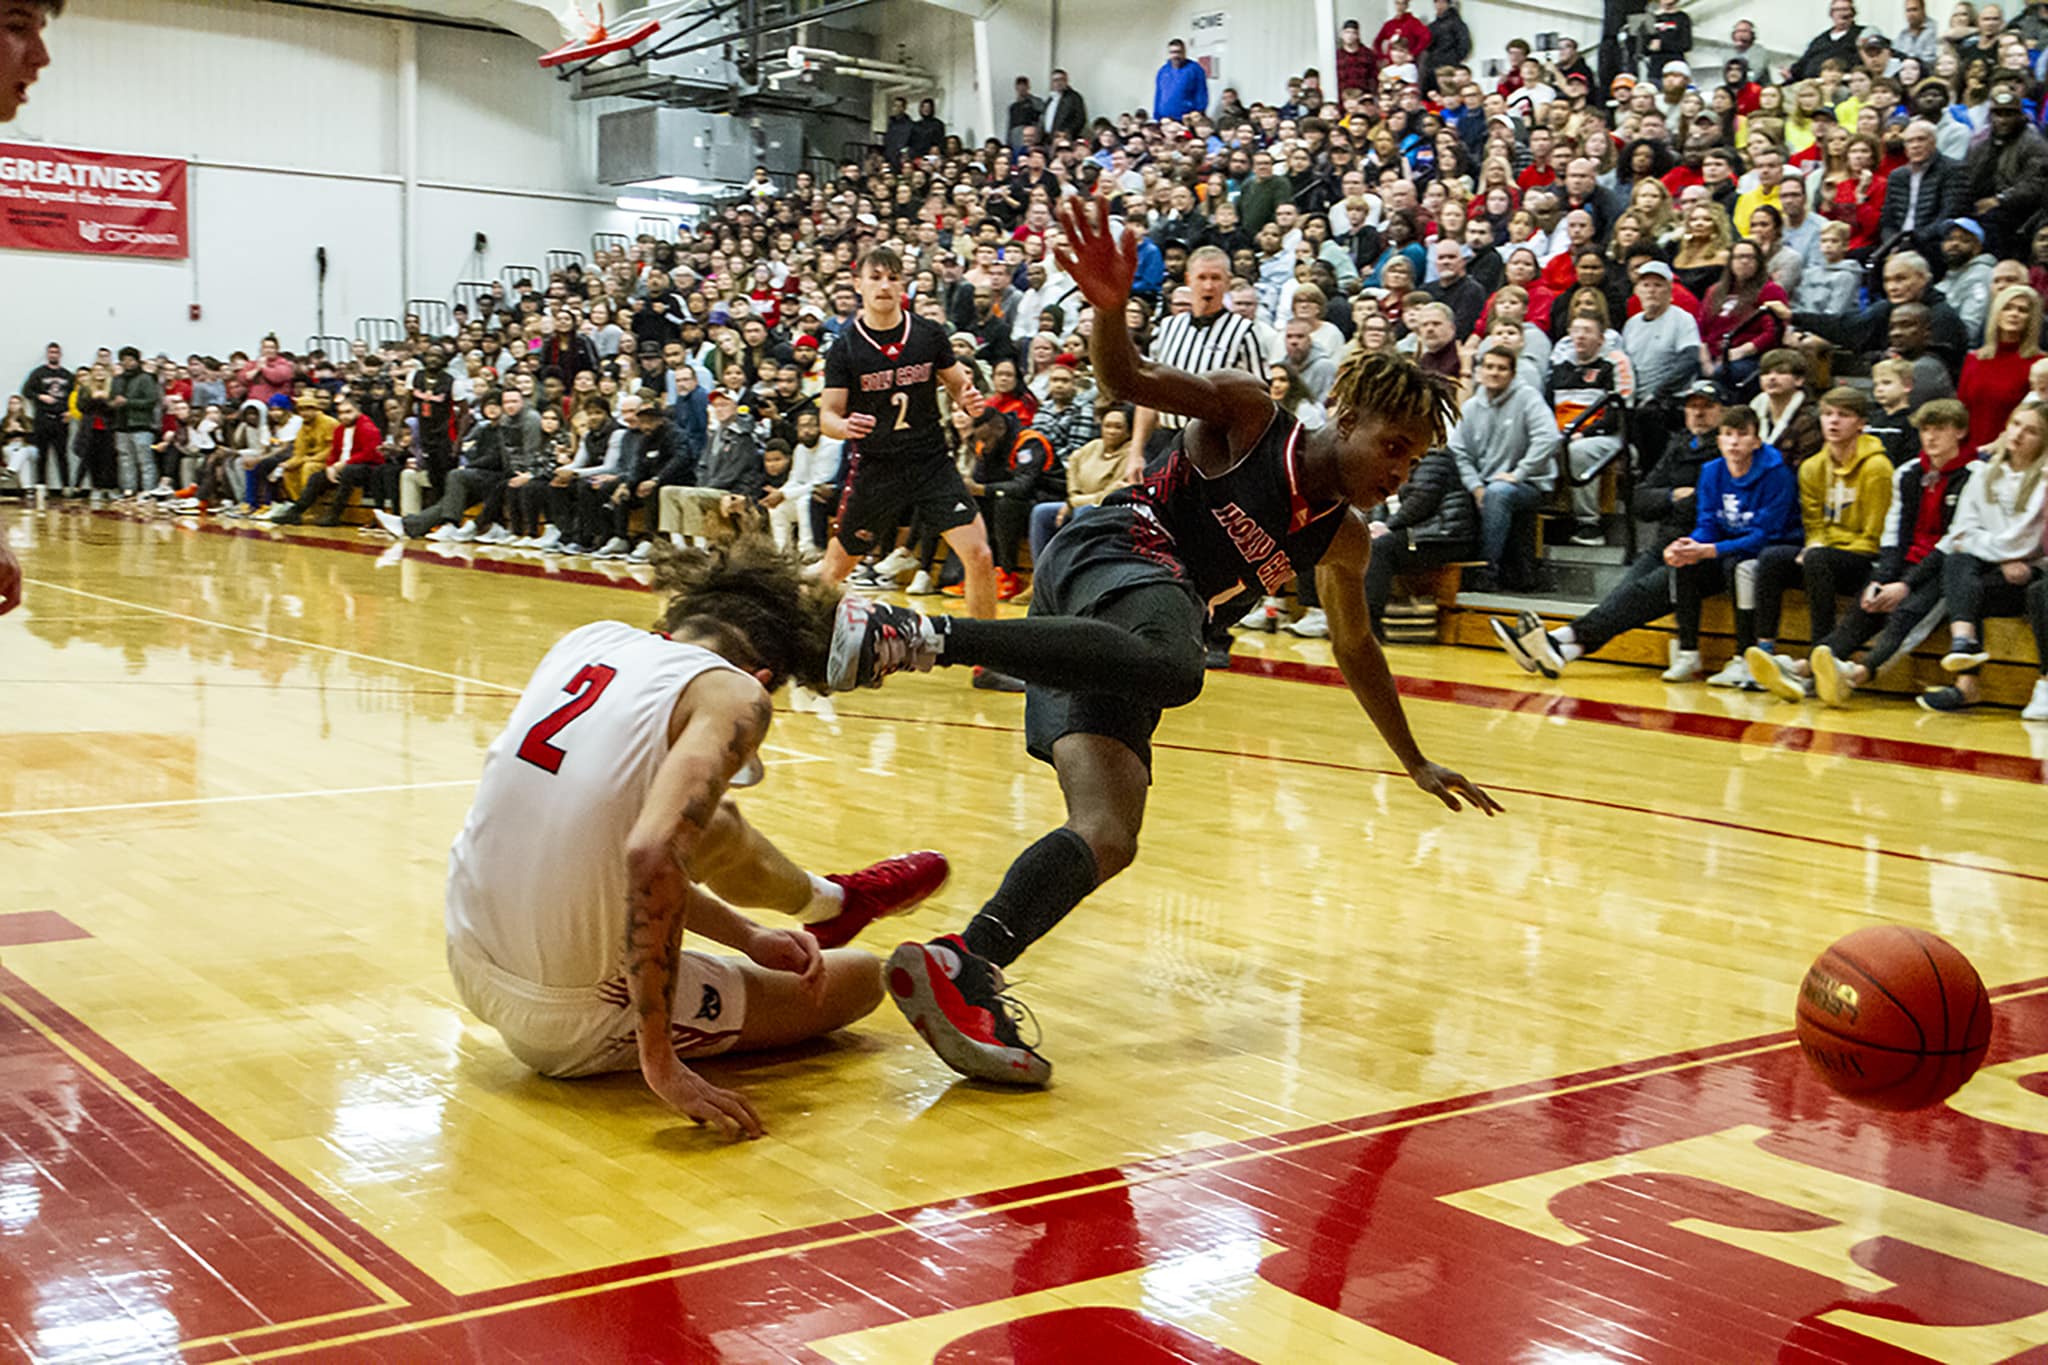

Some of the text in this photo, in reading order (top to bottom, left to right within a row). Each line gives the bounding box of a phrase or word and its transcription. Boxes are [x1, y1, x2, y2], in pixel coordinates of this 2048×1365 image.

[1192, 12, 1224, 30] HOME
[0, 156, 162, 194] GREATNESS
[890, 391, 911, 431] 2
[1210, 502, 1277, 563] HOLY
[1207, 576, 1248, 624] 1
[516, 663, 617, 775] 2
